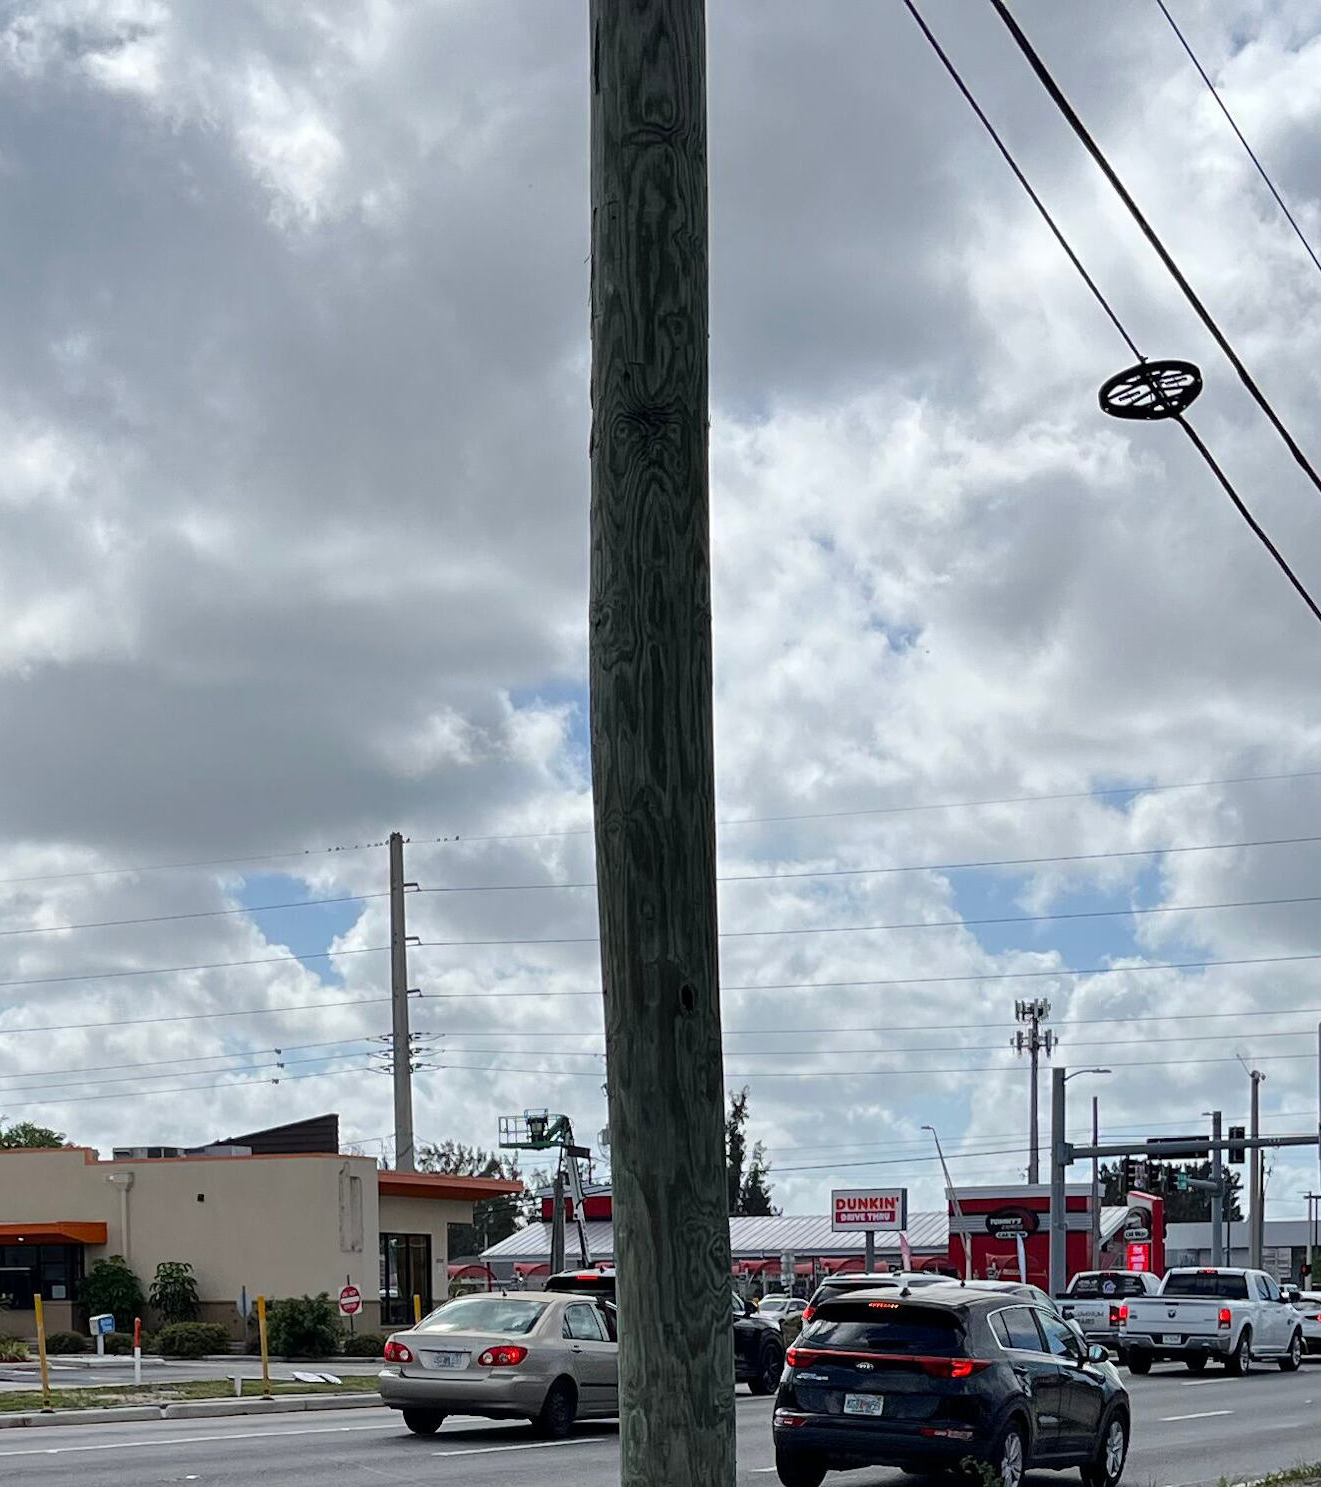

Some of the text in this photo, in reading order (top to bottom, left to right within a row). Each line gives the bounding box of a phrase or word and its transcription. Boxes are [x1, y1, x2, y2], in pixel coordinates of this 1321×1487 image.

[836, 1197, 900, 1210] DUNKIN'
[840, 1212, 890, 1221] DRIVE THRU
